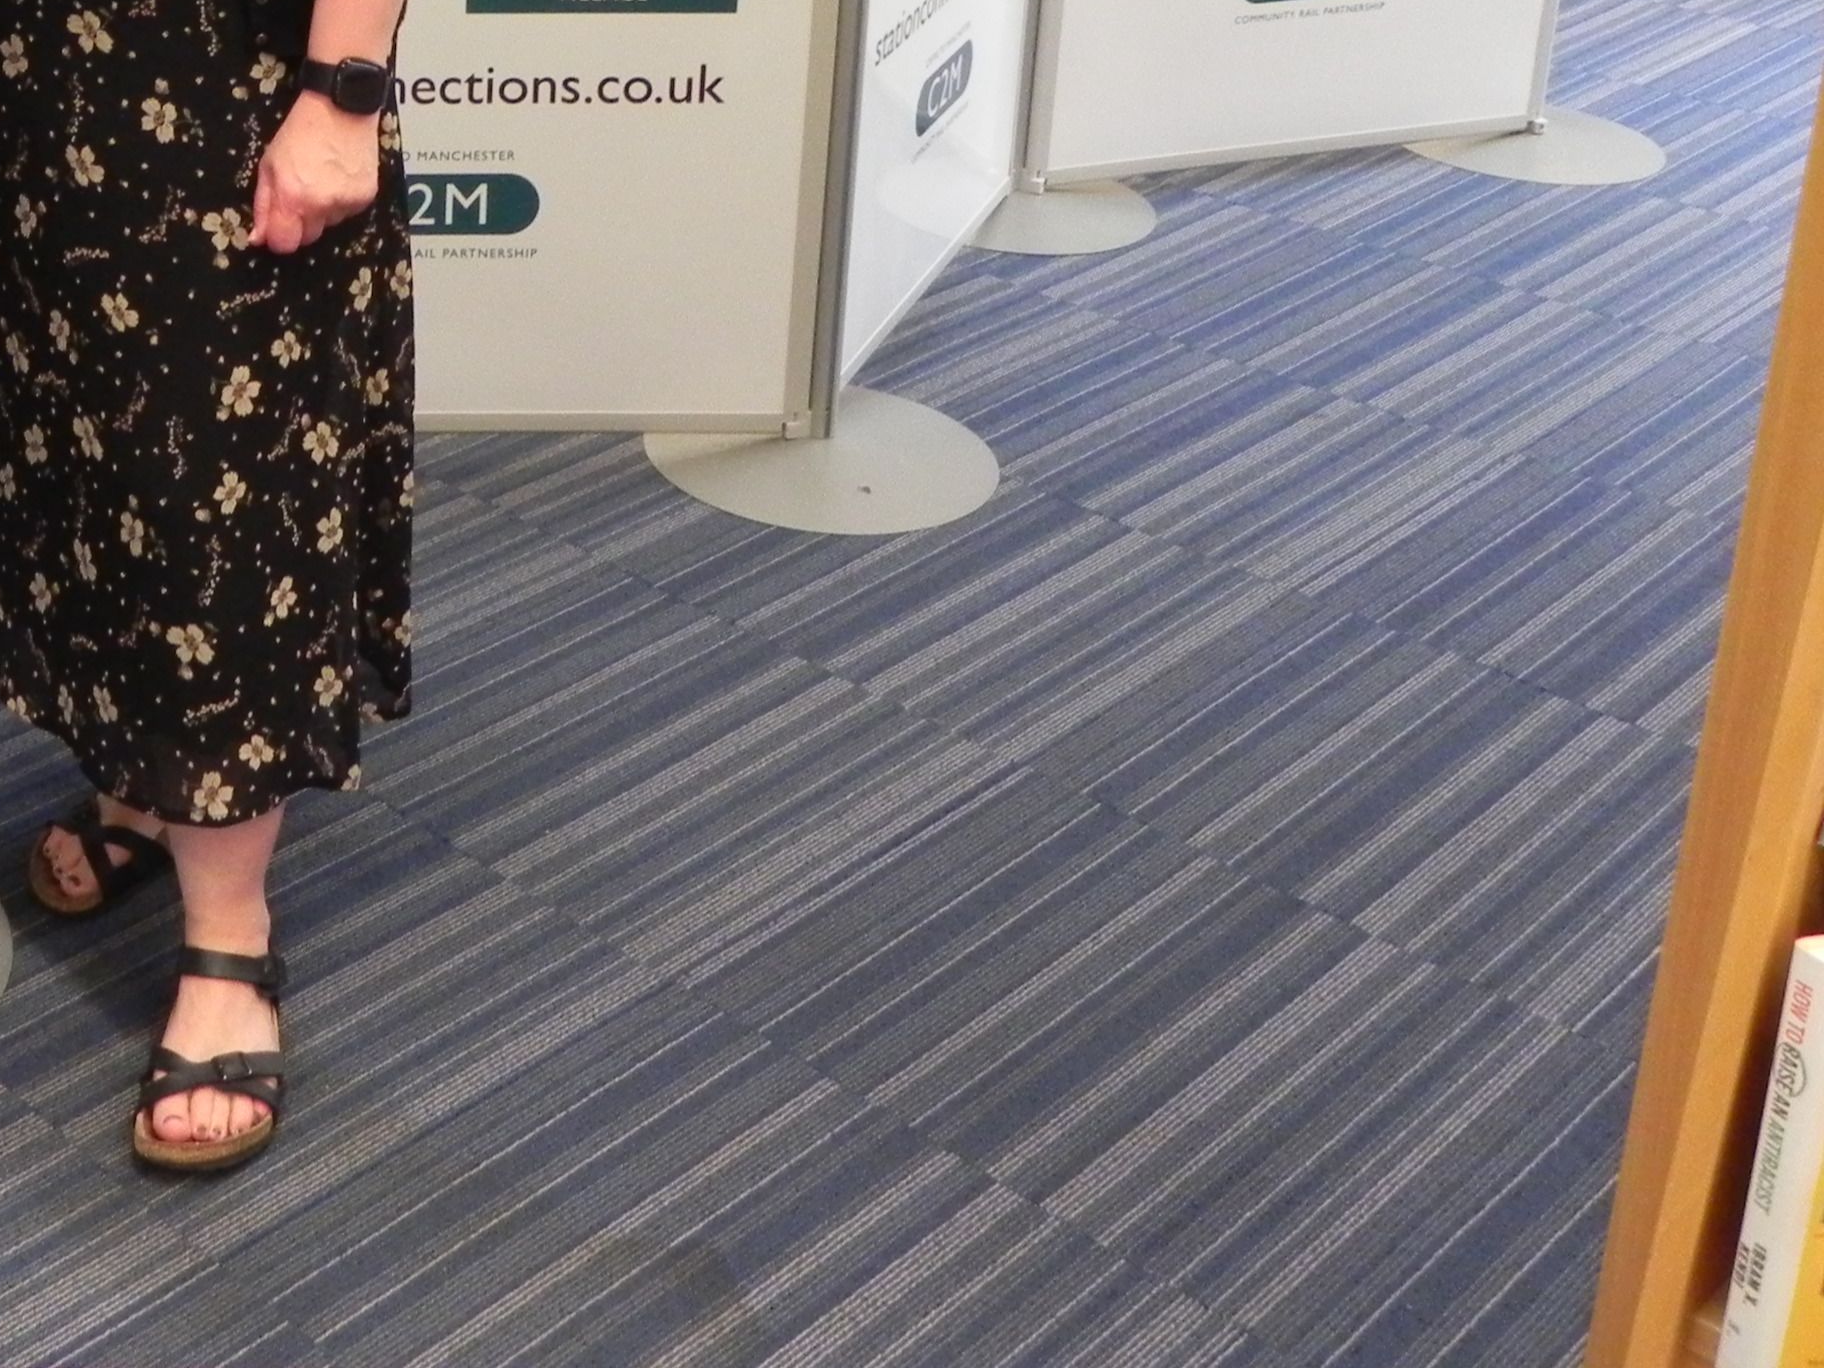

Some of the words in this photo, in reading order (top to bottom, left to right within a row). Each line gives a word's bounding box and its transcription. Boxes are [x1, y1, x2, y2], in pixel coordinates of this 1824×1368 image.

[1234, 10, 1295, 25] COMMUNITY
[1299, 7, 1320, 18] RAIL
[1323, 1, 1385, 16] PARTNERSHIP
[393, 64, 725, 105] nections.co.uk
[927, 54, 964, 118] C2M
[416, 150, 515, 161] MANCHESTER
[407, 183, 488, 226] 2M
[414, 248, 437, 259] AIL
[442, 248, 539, 260] PARTNERSHIP
[1789, 979, 1814, 1024] HOW
[1784, 1020, 1805, 1045] TO
[1775, 1041, 1801, 1098] RAISE
[1769, 1088, 1792, 1121] AN
[1753, 1118, 1786, 1217] ANTIRACIST
[1733, 1240, 1751, 1289] KENDI
[1746, 1242, 1768, 1293] IBRAM
